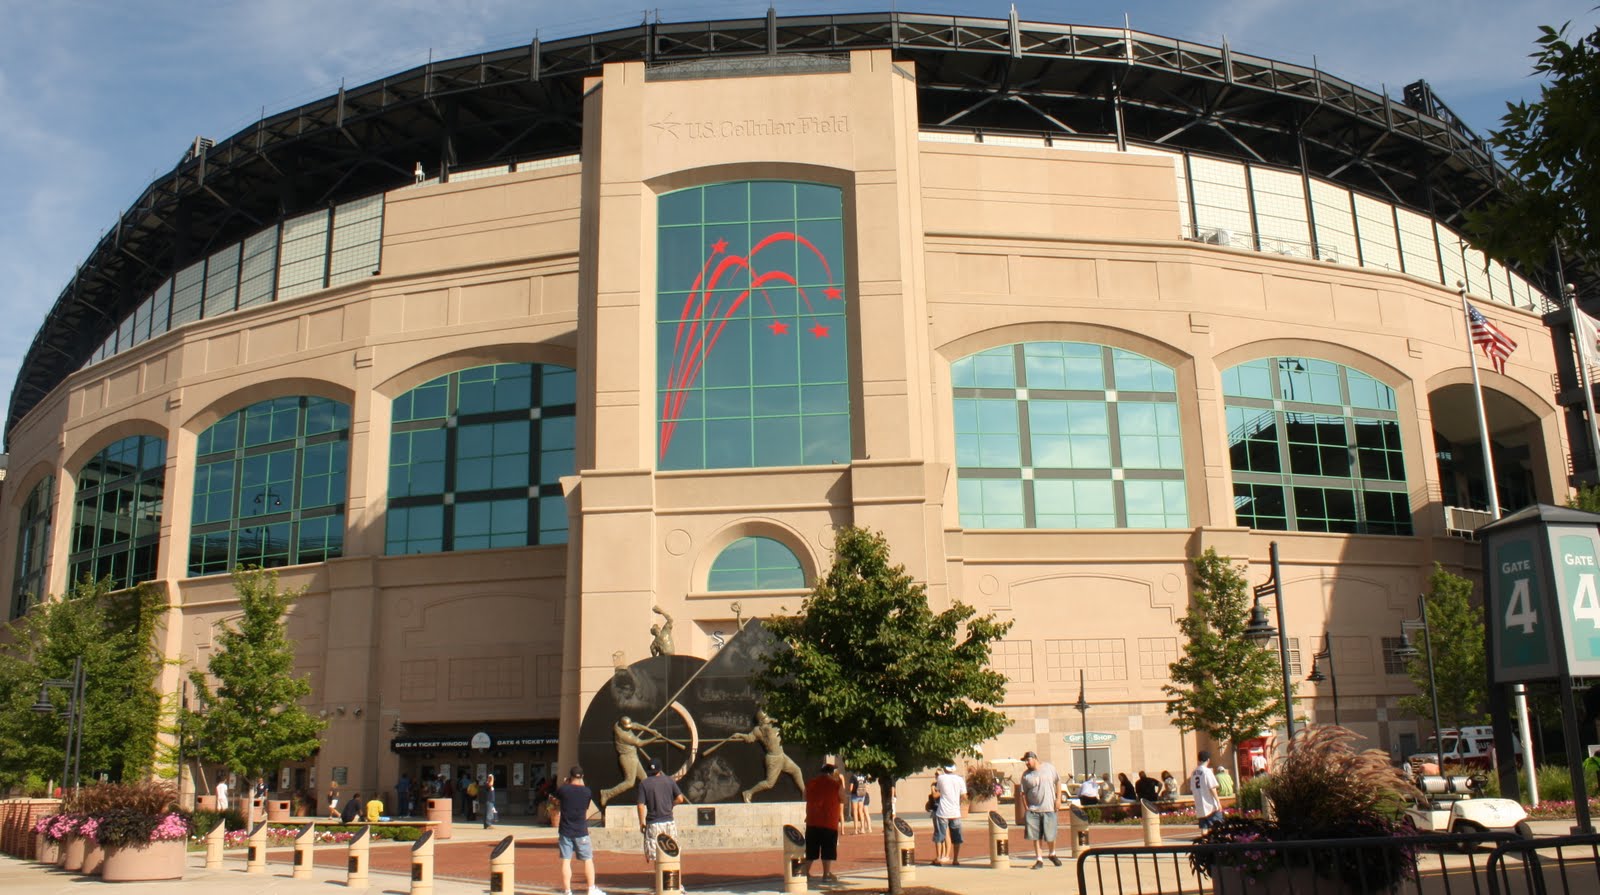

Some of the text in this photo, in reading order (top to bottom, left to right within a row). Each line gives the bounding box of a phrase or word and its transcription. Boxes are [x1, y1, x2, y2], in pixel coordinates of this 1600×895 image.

[685, 115, 849, 139] U.S. Cellular Field
[1502, 560, 1530, 574] GATE
[1565, 553, 1594, 566] GATE
[1505, 578, 1538, 634] 4
[1573, 573, 1600, 629] 4
[658, 839, 677, 851] 16
